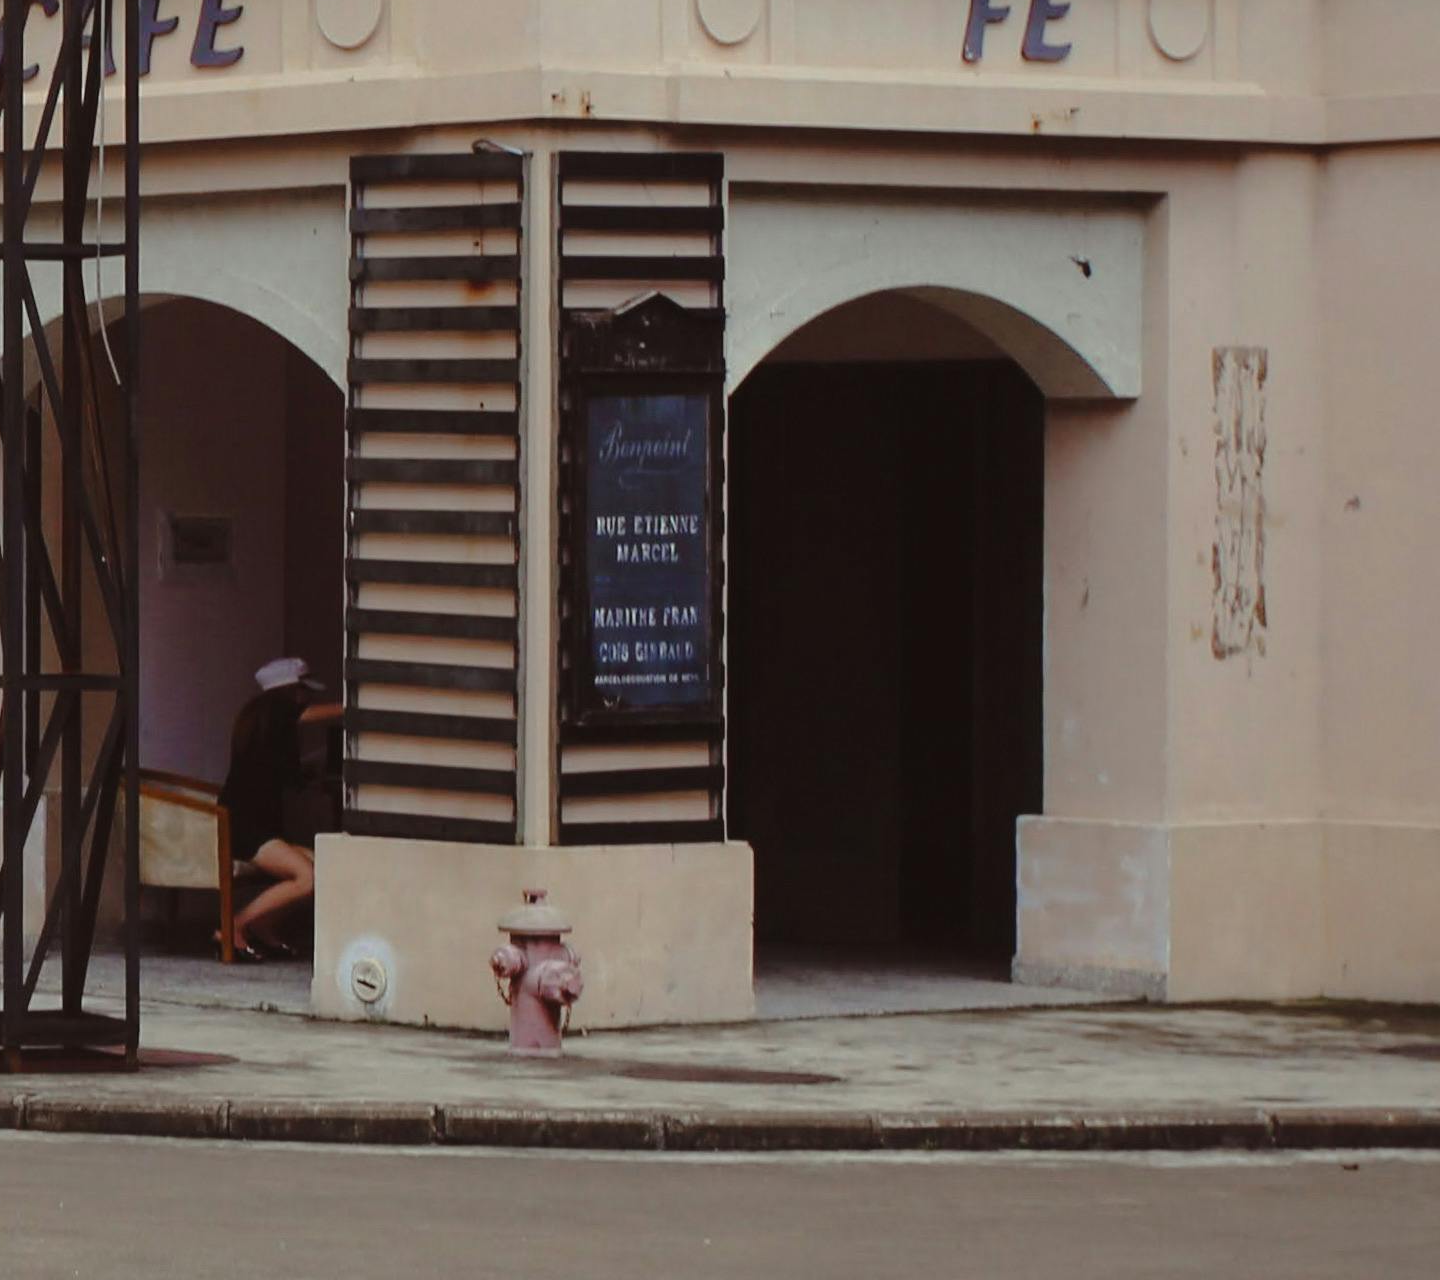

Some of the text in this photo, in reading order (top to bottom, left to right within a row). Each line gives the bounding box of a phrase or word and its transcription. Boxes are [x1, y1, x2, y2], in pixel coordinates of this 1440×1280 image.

[596, 515, 699, 537] RUE ETIENNE
[616, 543, 679, 563] MARCEL
